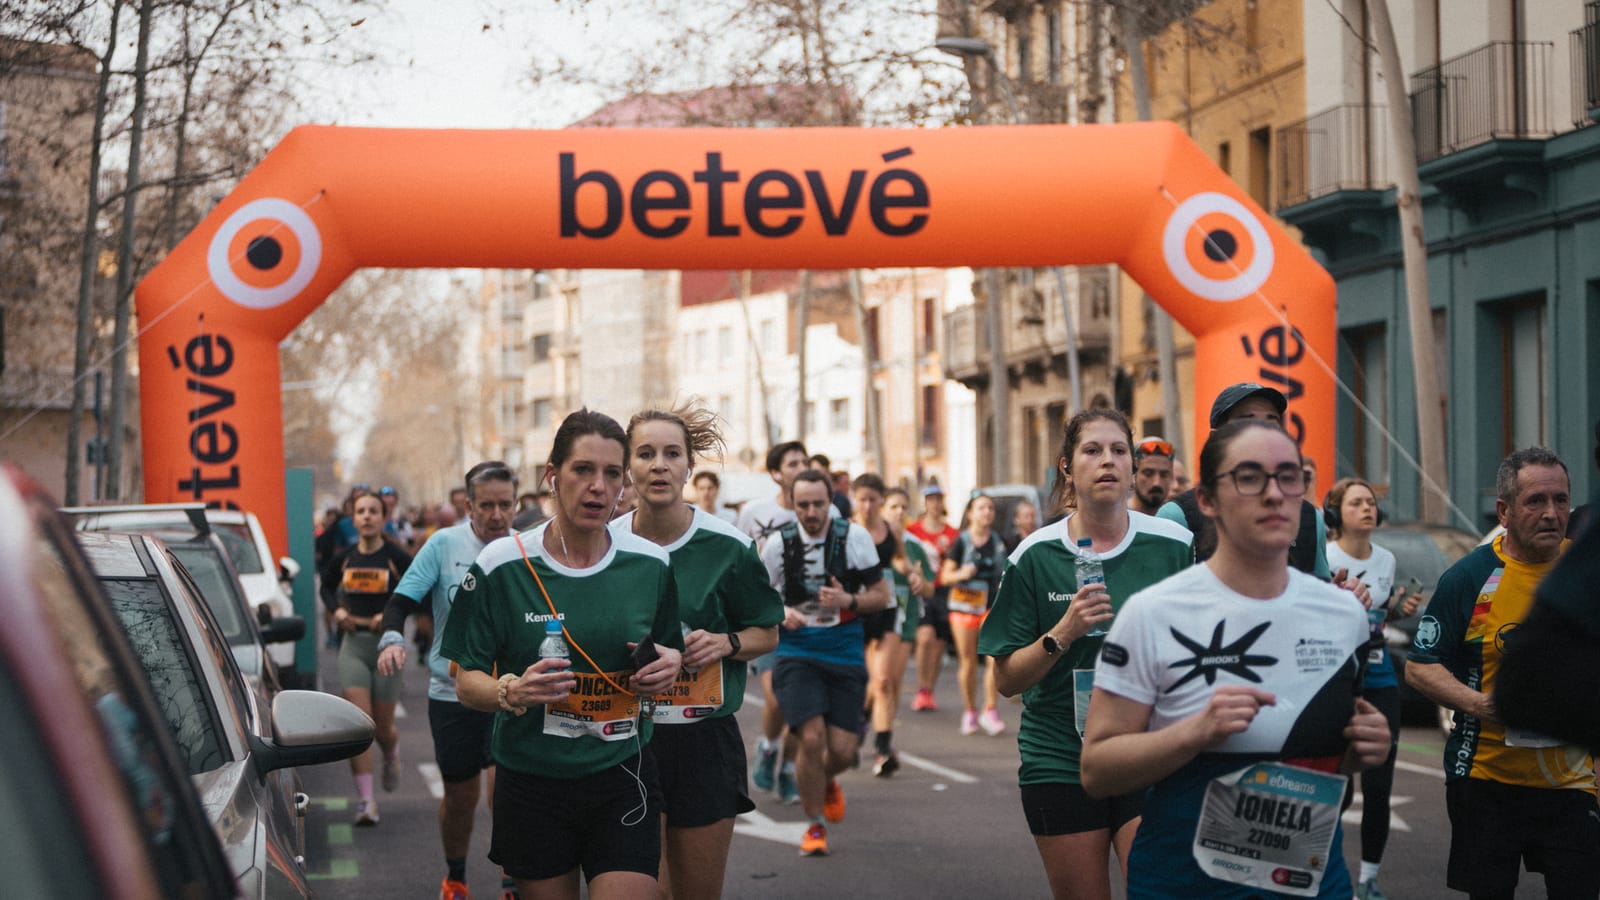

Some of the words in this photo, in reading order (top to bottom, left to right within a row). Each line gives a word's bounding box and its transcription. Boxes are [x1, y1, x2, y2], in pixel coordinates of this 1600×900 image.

[558, 146, 931, 240] betevé
[167, 332, 241, 511] tevé
[1048, 592, 1076, 602] Kem
[525, 612, 565, 623] Kema
[1202, 655, 1240, 665] BROOKS
[1269, 775, 1316, 794] eDreams
[1234, 793, 1312, 833] IONELA
[1247, 828, 1290, 850] 27090
